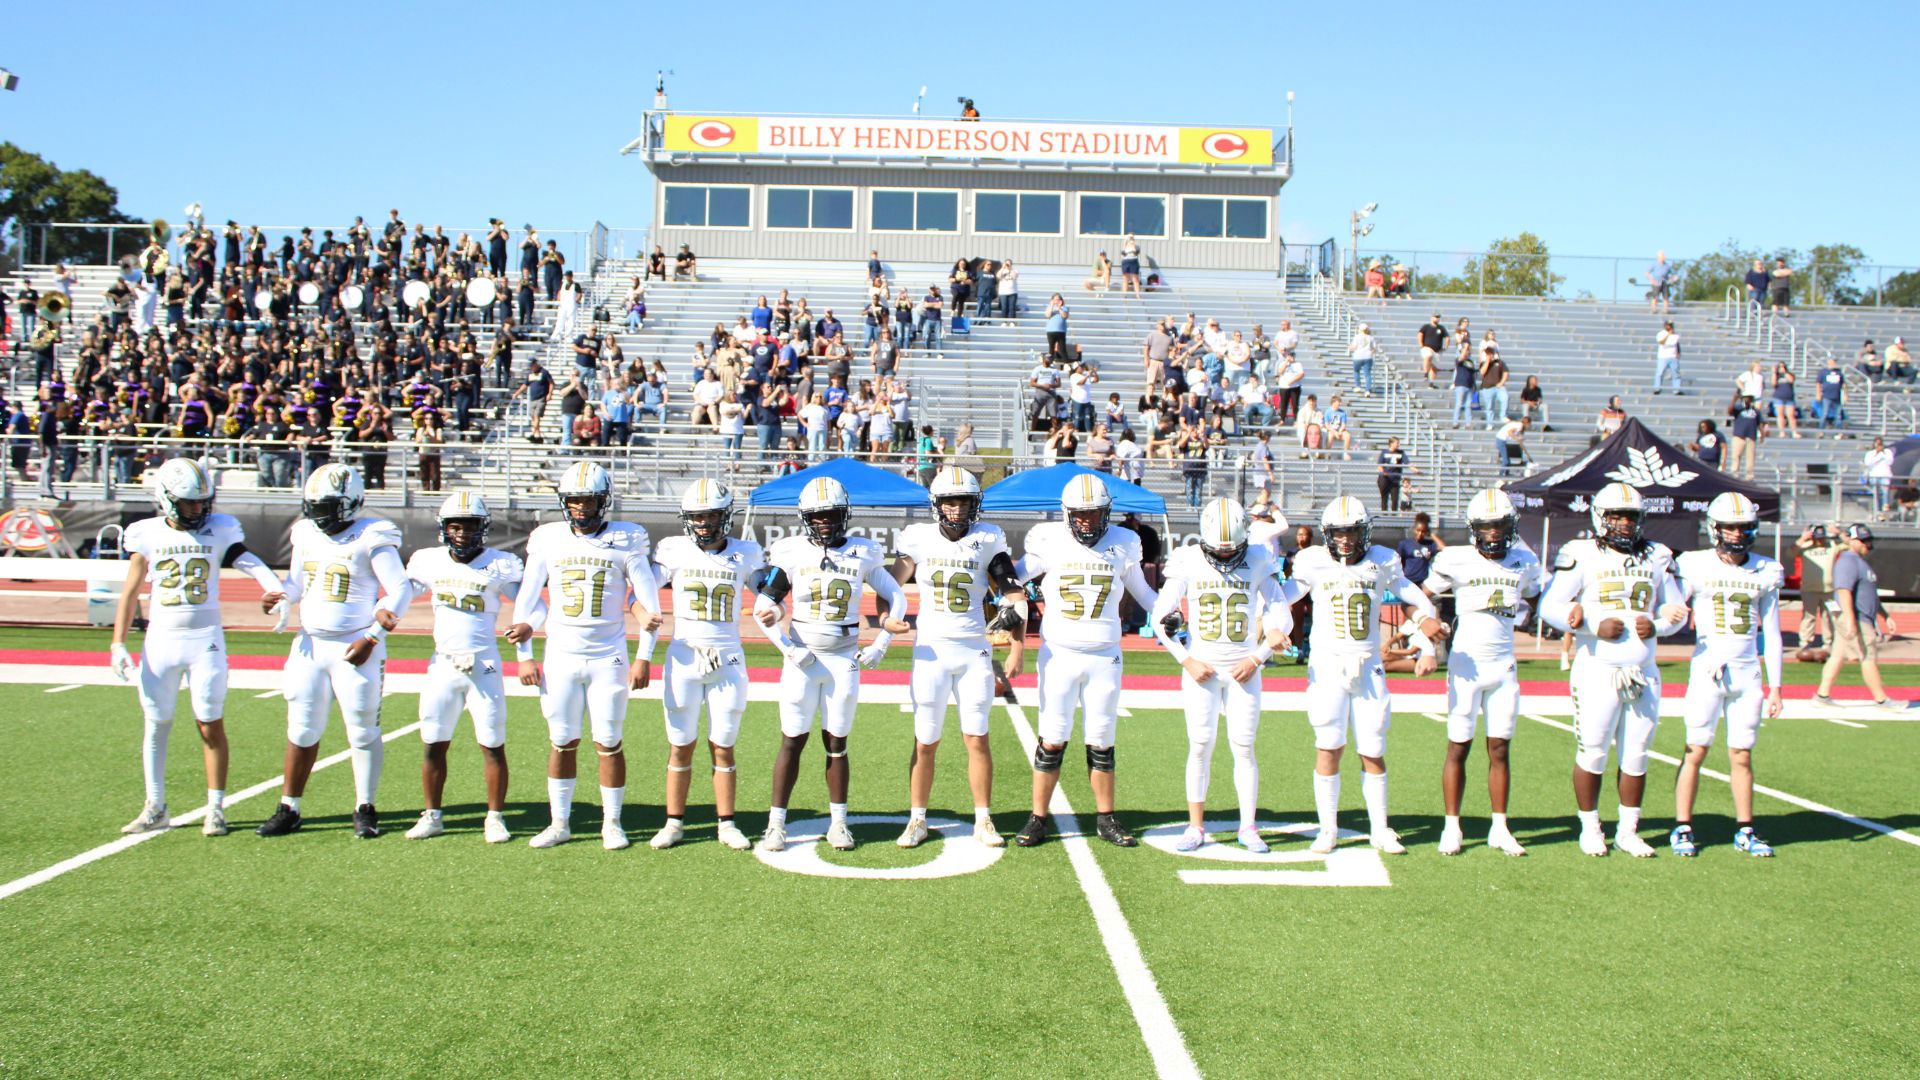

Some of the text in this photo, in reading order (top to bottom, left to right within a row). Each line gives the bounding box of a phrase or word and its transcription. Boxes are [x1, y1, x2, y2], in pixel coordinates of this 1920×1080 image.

[769, 125, 1168, 155] BILLY HENDERSON STADIUM
[561, 569, 605, 617] 51
[809, 578, 852, 621] 19
[931, 570, 974, 613] 16
[1060, 574, 1114, 620] 57
[1712, 592, 1751, 634] 13
[1331, 593, 1371, 640] 10
